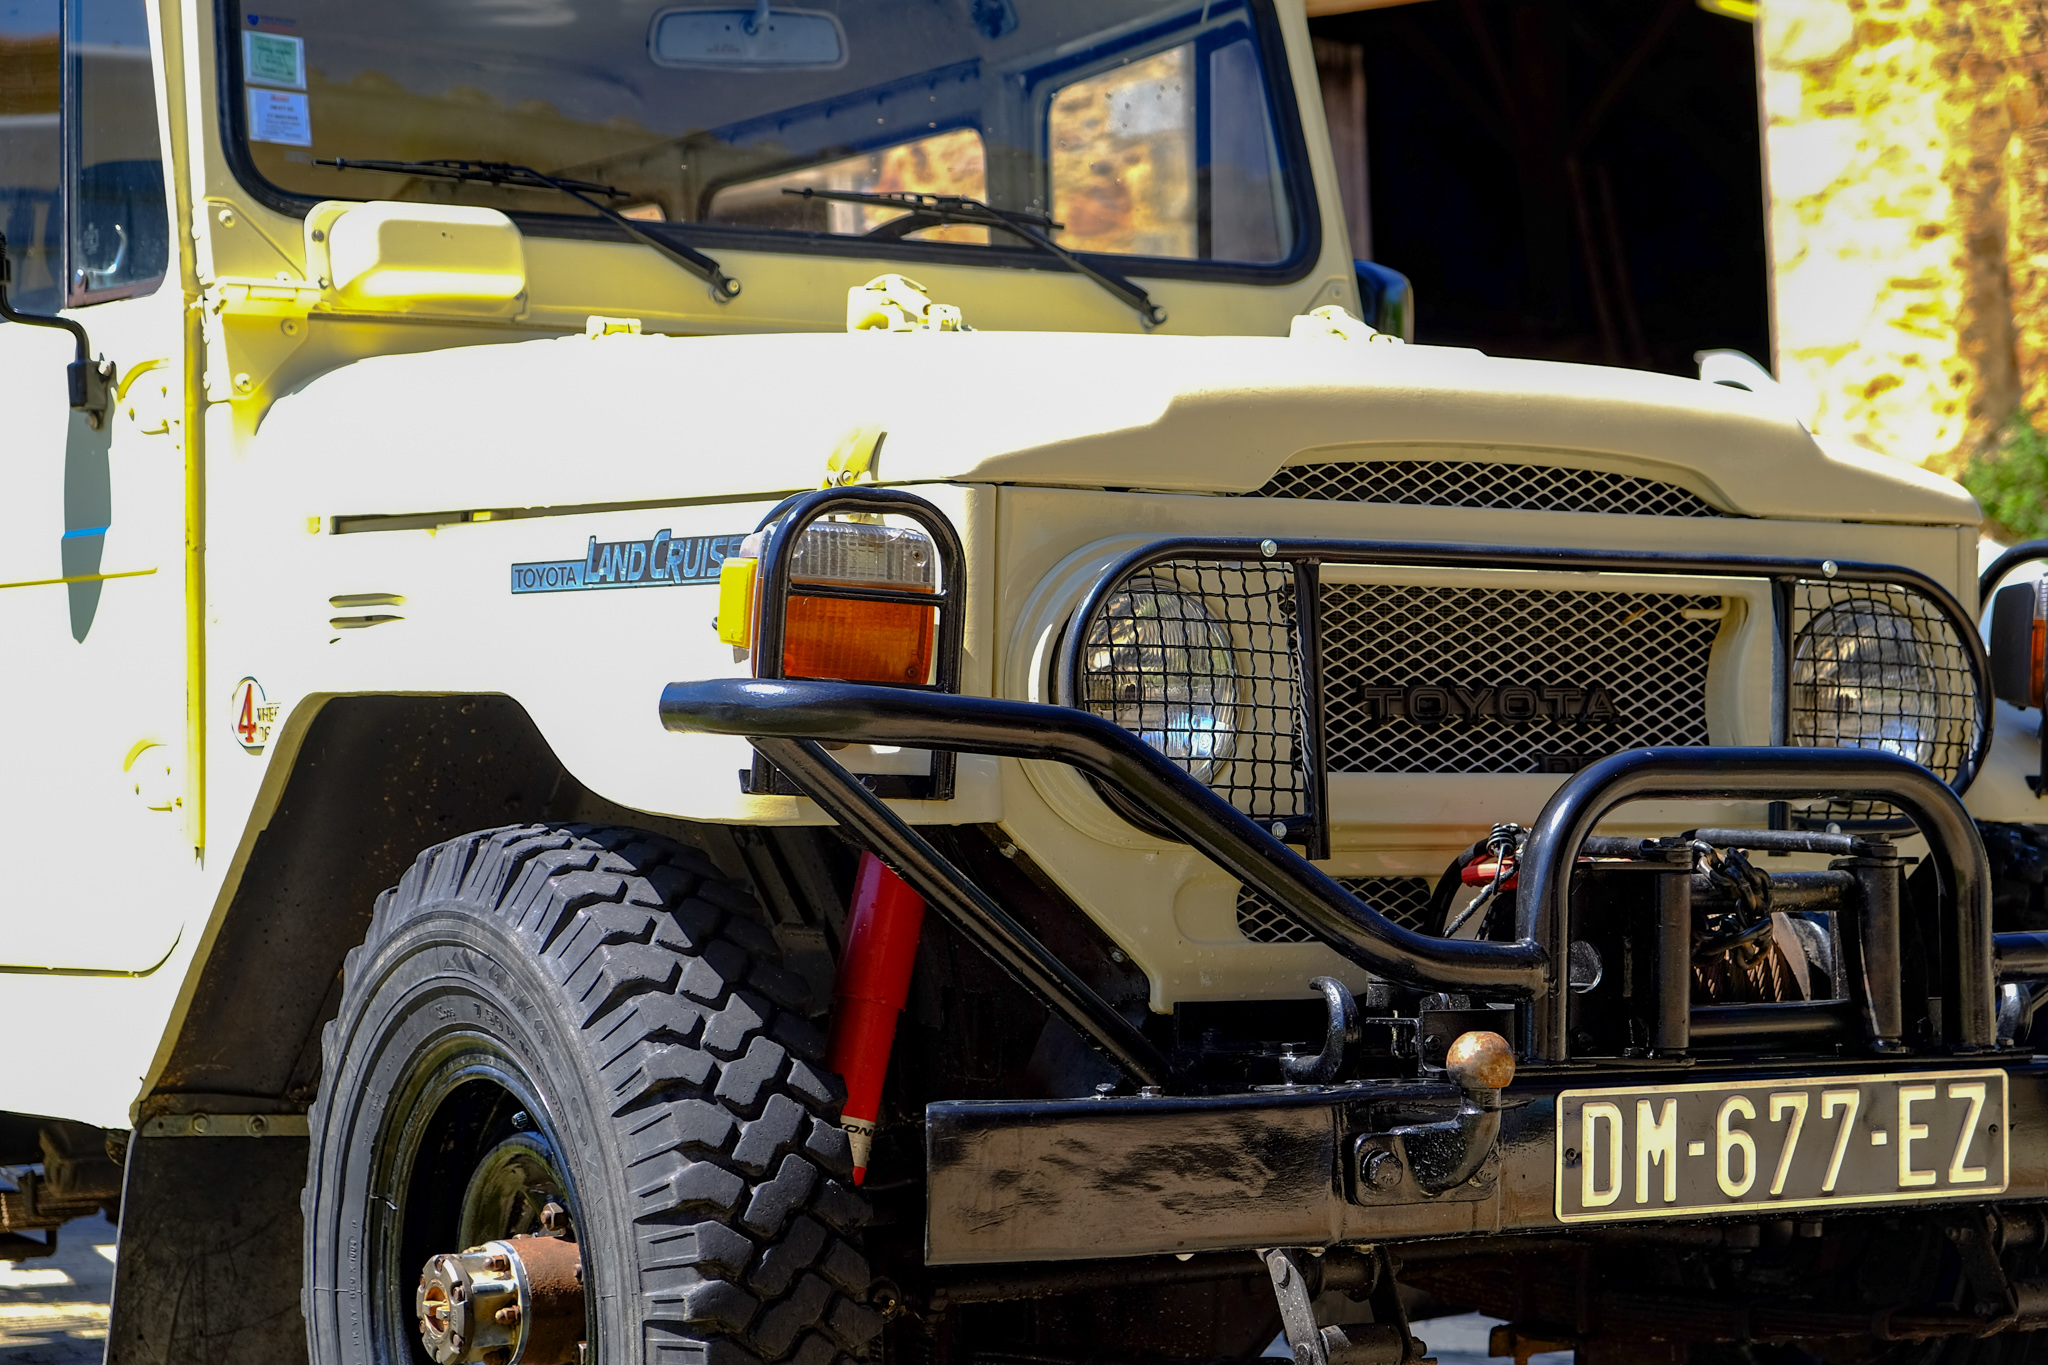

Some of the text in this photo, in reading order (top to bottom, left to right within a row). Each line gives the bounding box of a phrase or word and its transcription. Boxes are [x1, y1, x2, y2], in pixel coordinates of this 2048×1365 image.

[514, 566, 577, 588] TOYOTA
[583, 535, 647, 585] LAND
[238, 683, 257, 743] 4
[1361, 683, 1621, 724] TOYOTA
[1581, 1082, 1987, 1208] DM-677-EZ
